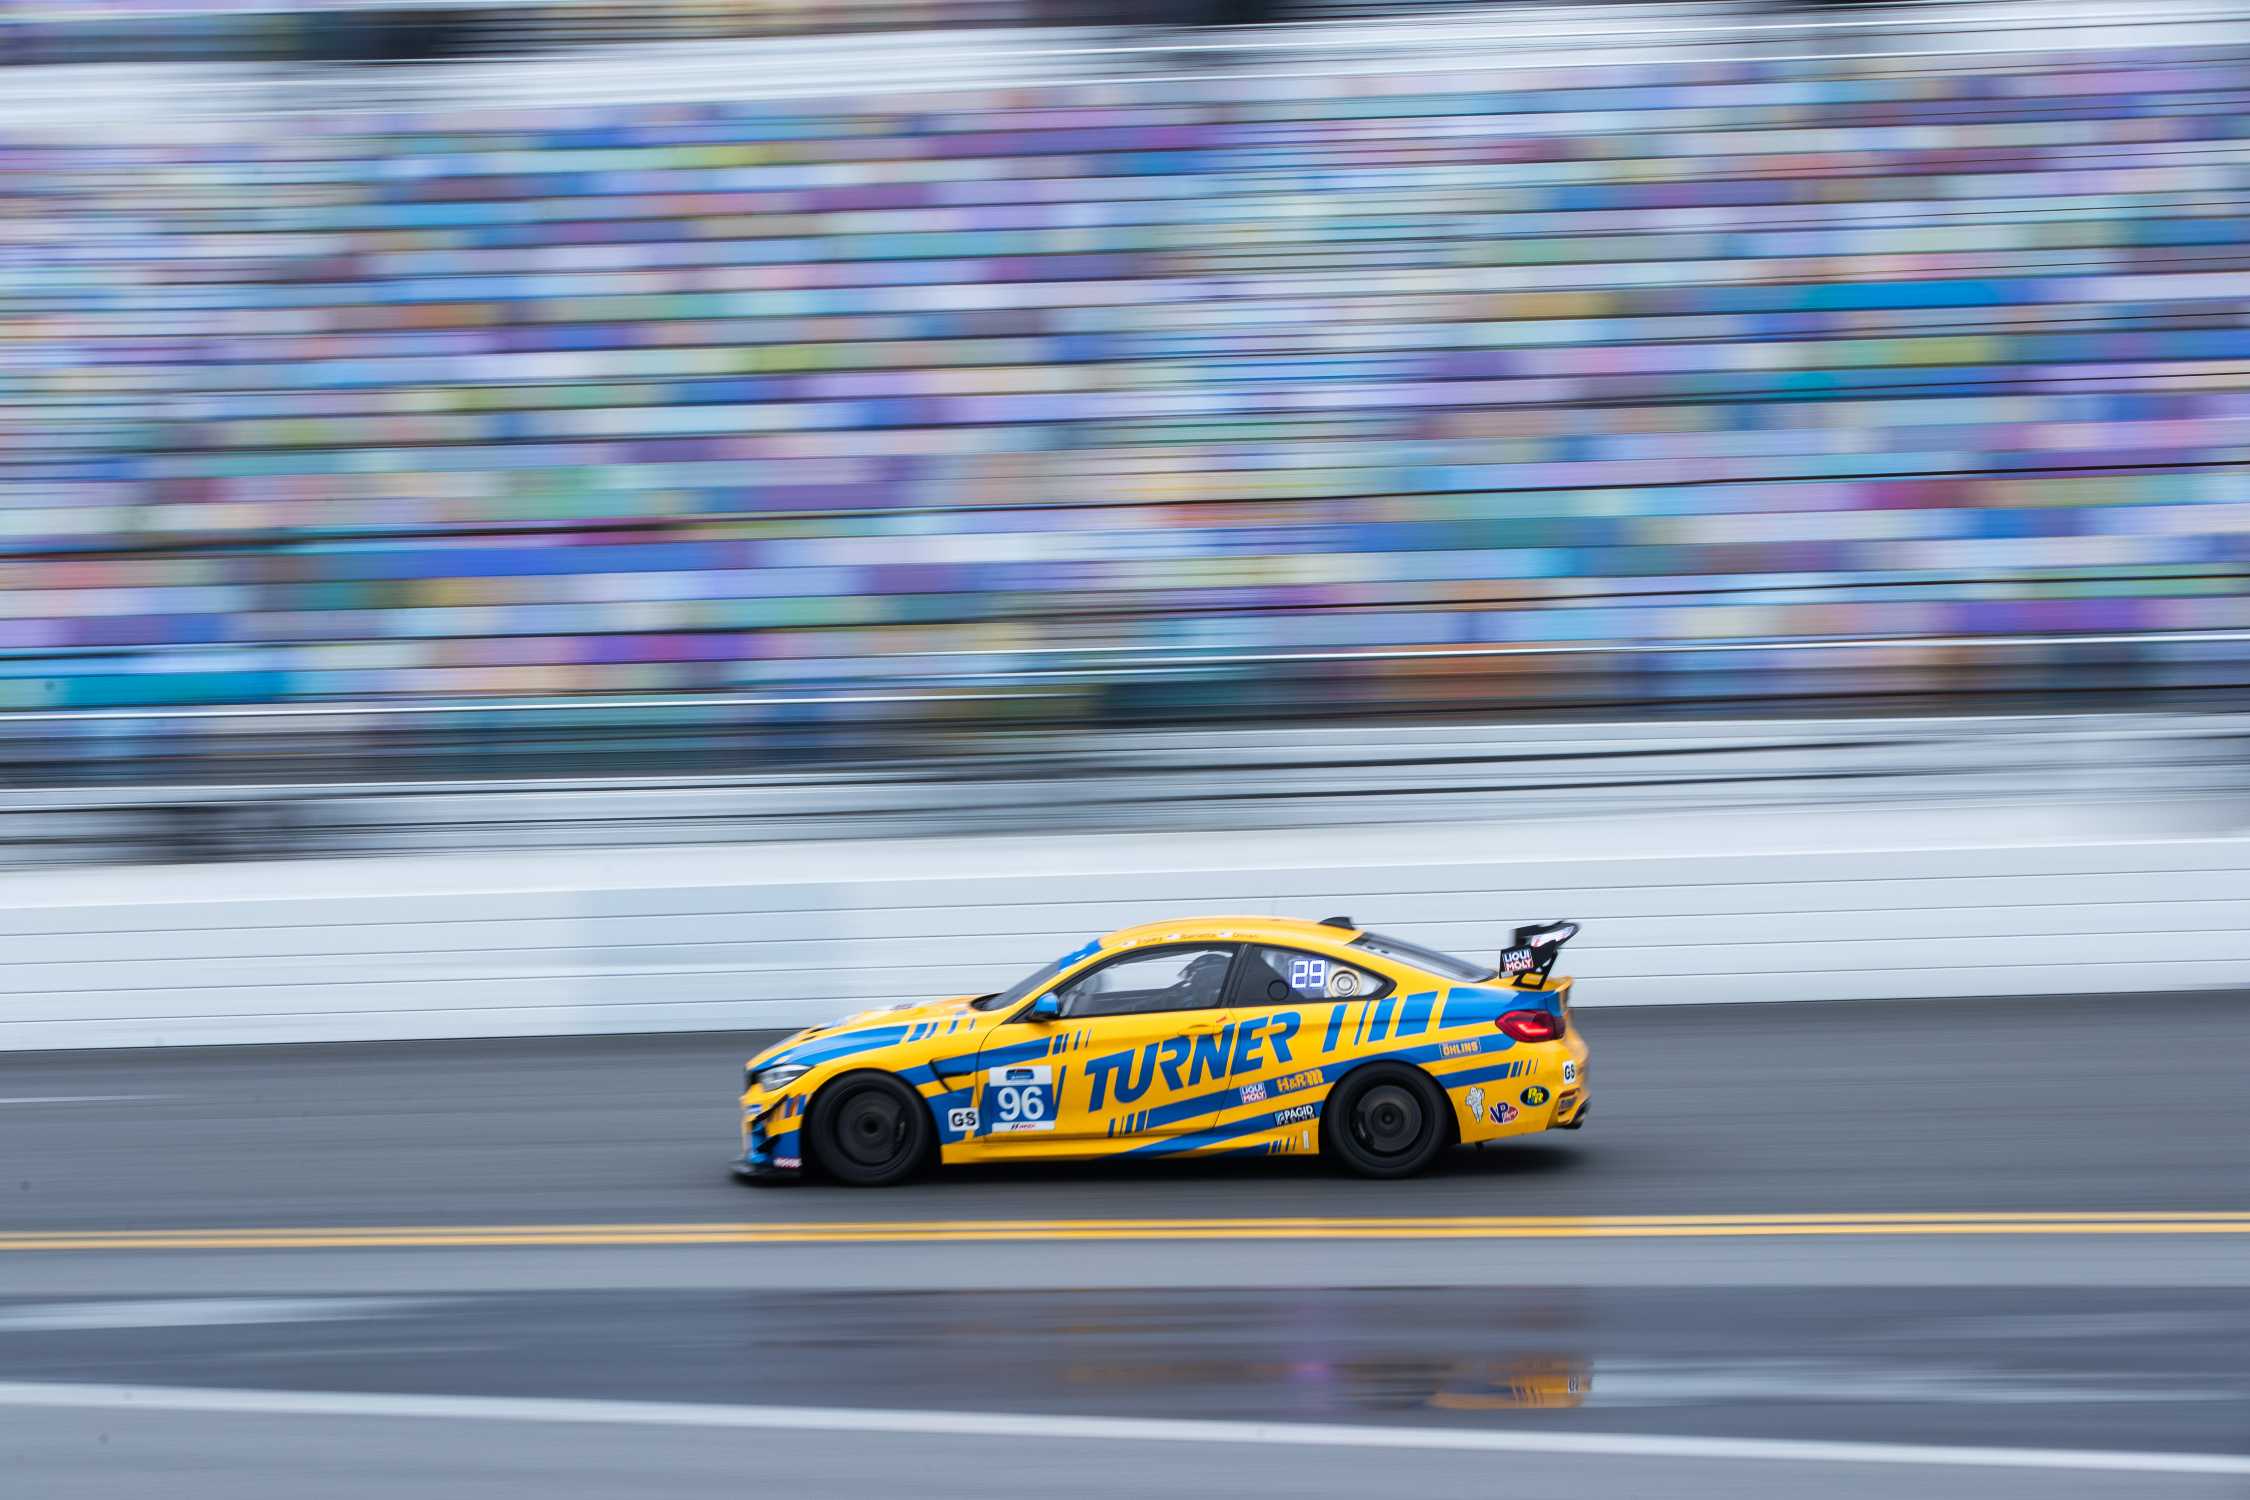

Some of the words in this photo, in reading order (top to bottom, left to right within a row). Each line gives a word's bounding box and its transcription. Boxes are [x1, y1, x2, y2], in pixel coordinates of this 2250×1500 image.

[1504, 949, 1531, 963] LIQUI
[1292, 959, 1326, 988] 29
[1505, 959, 1532, 972] MOLY
[1084, 1011, 1301, 1113] TURNER
[1564, 1063, 1576, 1081] GS
[1241, 1081, 1265, 1095] LIQUI
[997, 1086, 1045, 1121] 96
[1242, 1091, 1266, 1103] MOLY
[951, 1110, 977, 1127] GS
[1284, 1104, 1313, 1120] PAGID
